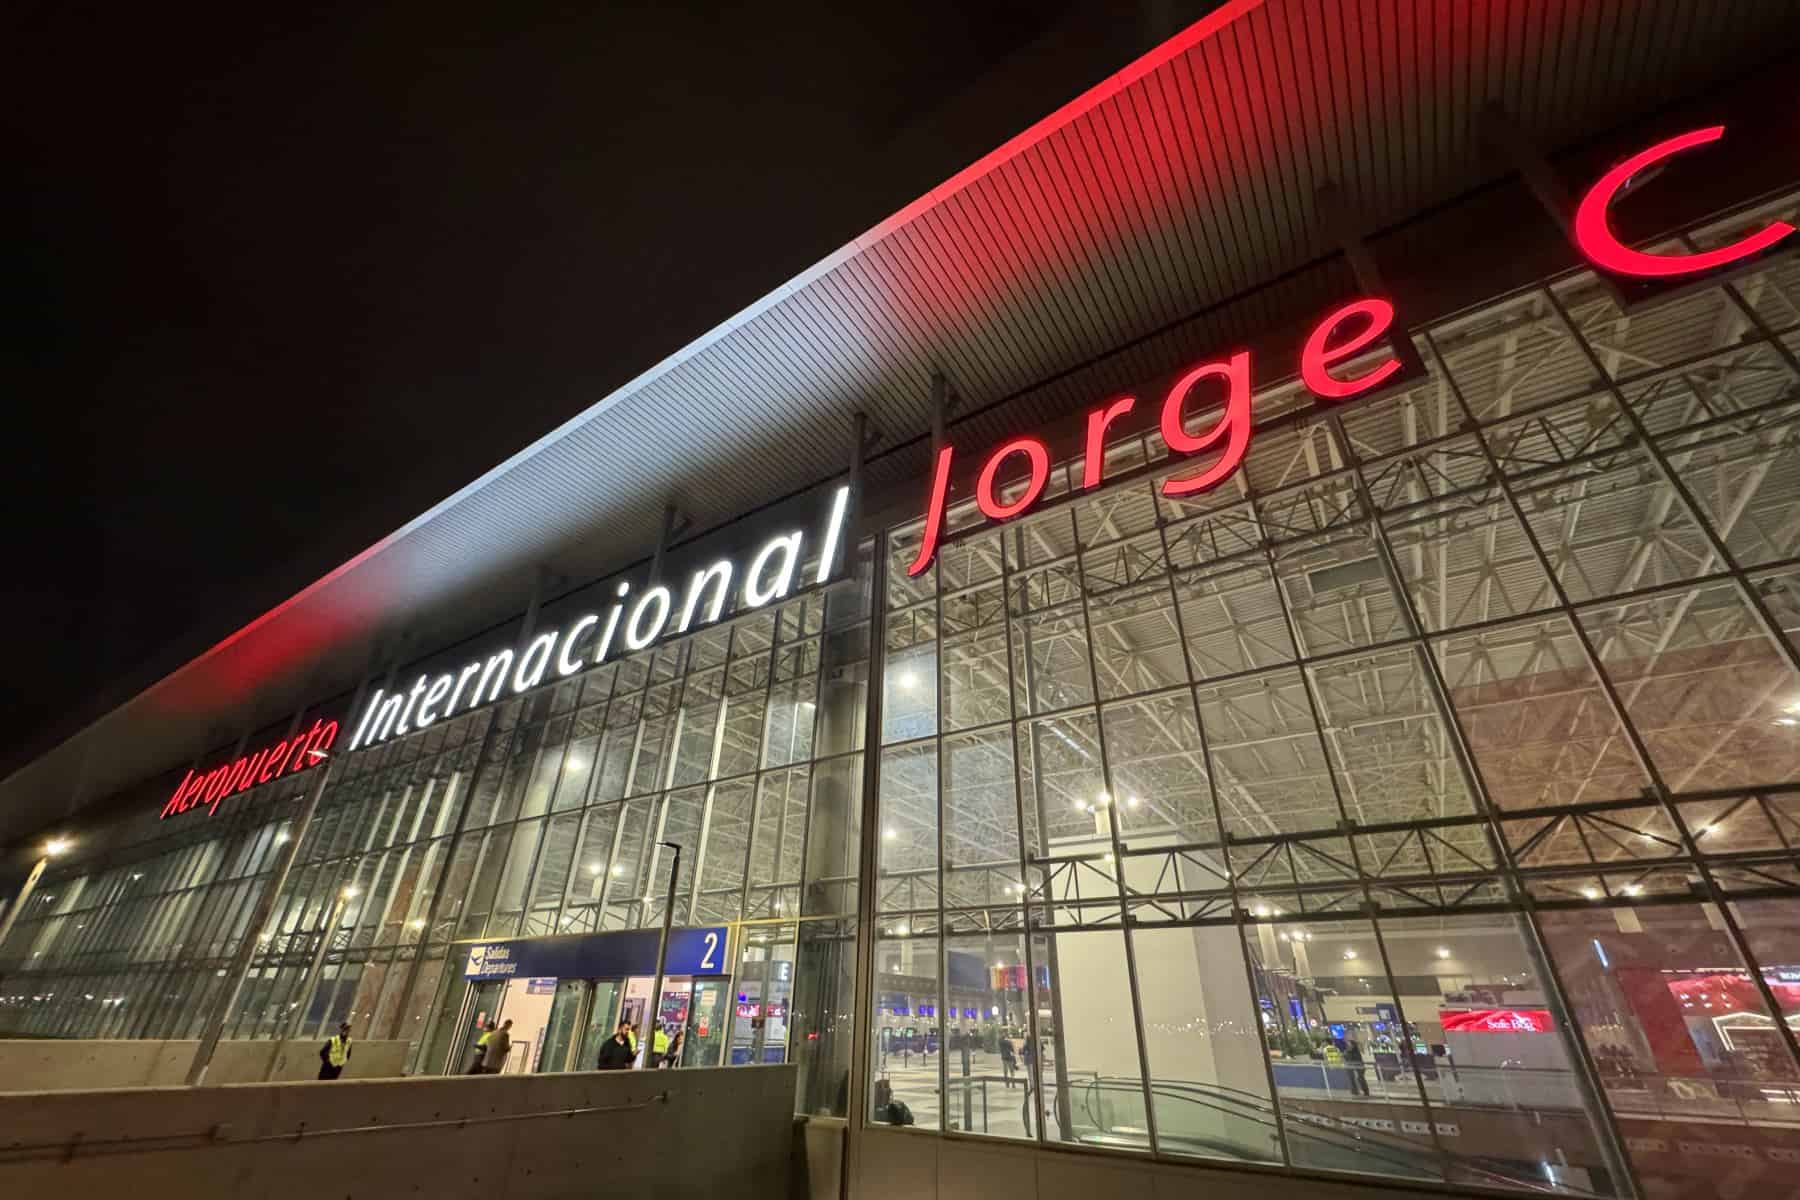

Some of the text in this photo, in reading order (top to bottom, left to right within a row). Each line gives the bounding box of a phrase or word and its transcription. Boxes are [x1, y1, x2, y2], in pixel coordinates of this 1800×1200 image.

[160, 719, 338, 820] Aeropuerto
[350, 486, 849, 751] Internacional
[908, 299, 1401, 577] Jorge
[701, 932, 718, 969] 2
